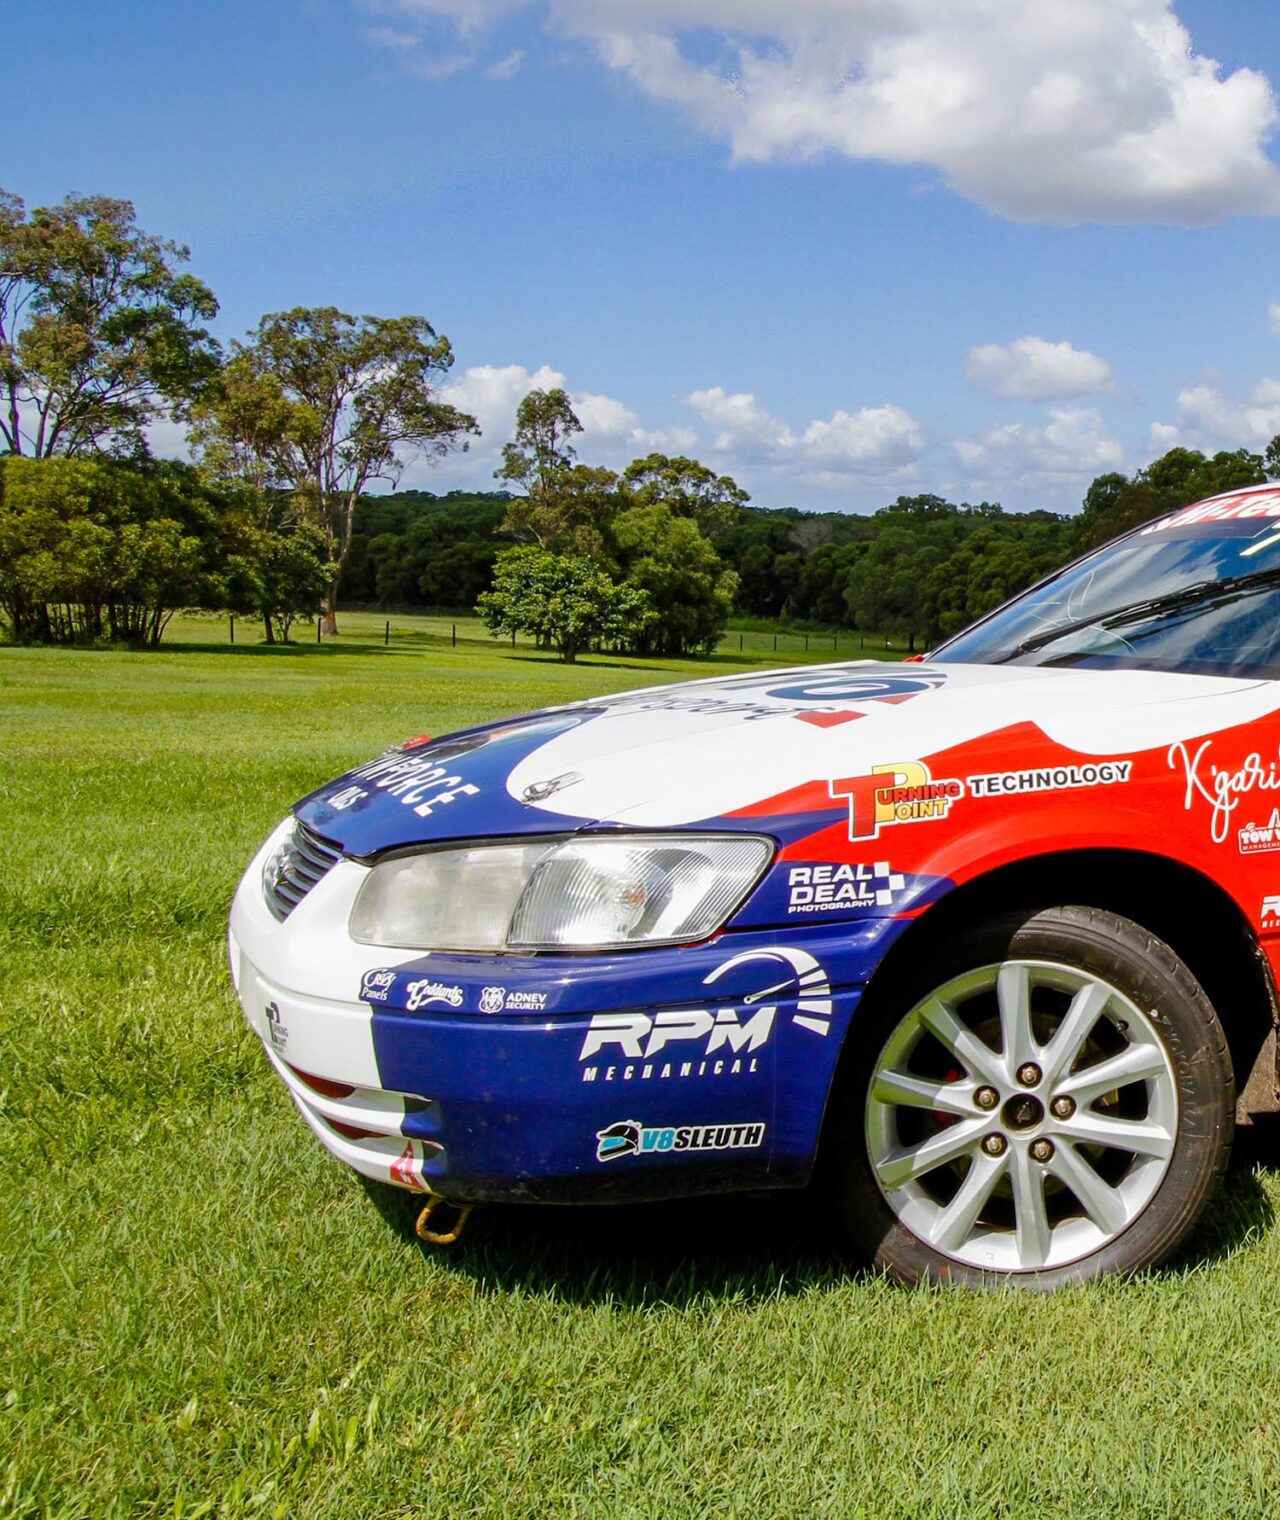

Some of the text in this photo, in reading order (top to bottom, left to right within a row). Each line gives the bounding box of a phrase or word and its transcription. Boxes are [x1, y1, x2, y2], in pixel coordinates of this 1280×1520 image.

[970, 764, 1130, 794] TECHNOLOGY
[872, 761, 948, 823] POINT
[832, 771, 961, 838] TURNING
[1241, 829, 1274, 844] TOW
[788, 863, 874, 886] REAL
[790, 882, 875, 905] DEAL
[788, 899, 874, 914] PHOTOGRAPHY
[361, 986, 388, 1001] Panels
[406, 979, 464, 1012] Goddards
[507, 992, 547, 1003] ADNEV
[505, 1001, 545, 1010] SECURITY
[578, 1006, 777, 1062] RPM
[582, 1058, 758, 1082] MECHANICAL
